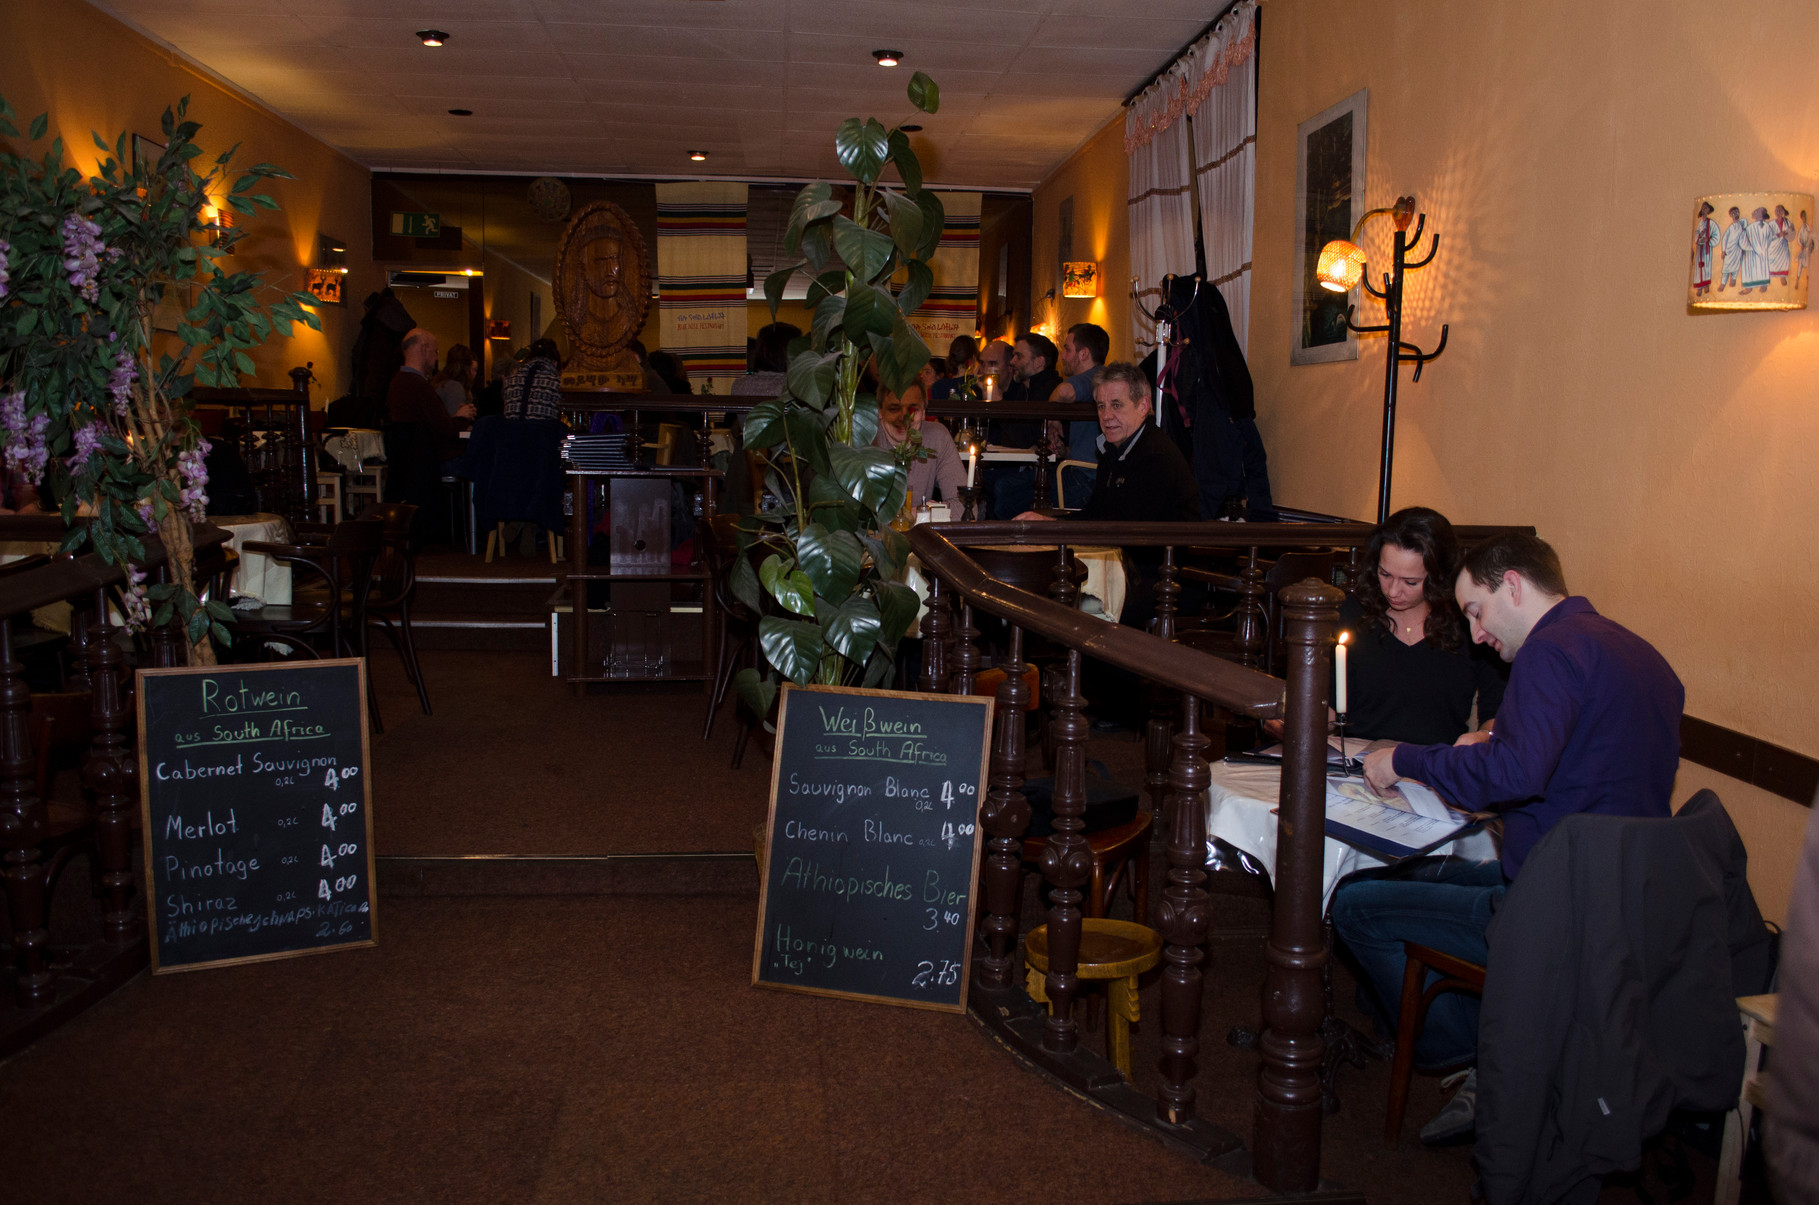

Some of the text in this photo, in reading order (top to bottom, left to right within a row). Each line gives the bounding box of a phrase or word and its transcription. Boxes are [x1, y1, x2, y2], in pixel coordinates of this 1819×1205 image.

[202, 679, 301, 713] Rotwein
[175, 719, 325, 743] aus South Africa
[819, 705, 922, 741] Weißwein
[156, 752, 337, 781] Cabernet Sauvignon
[815, 740, 947, 763] aus South Africa
[789, 772, 872, 804] Sauvignon
[885, 776, 930, 799] Blanc
[165, 808, 238, 840] Merlot
[785, 820, 849, 843] Chenin
[864, 819, 913, 846] Blanc
[165, 848, 260, 880] Pinotage
[923, 869, 967, 906] Bier
[167, 894, 238, 918] Shiraz
